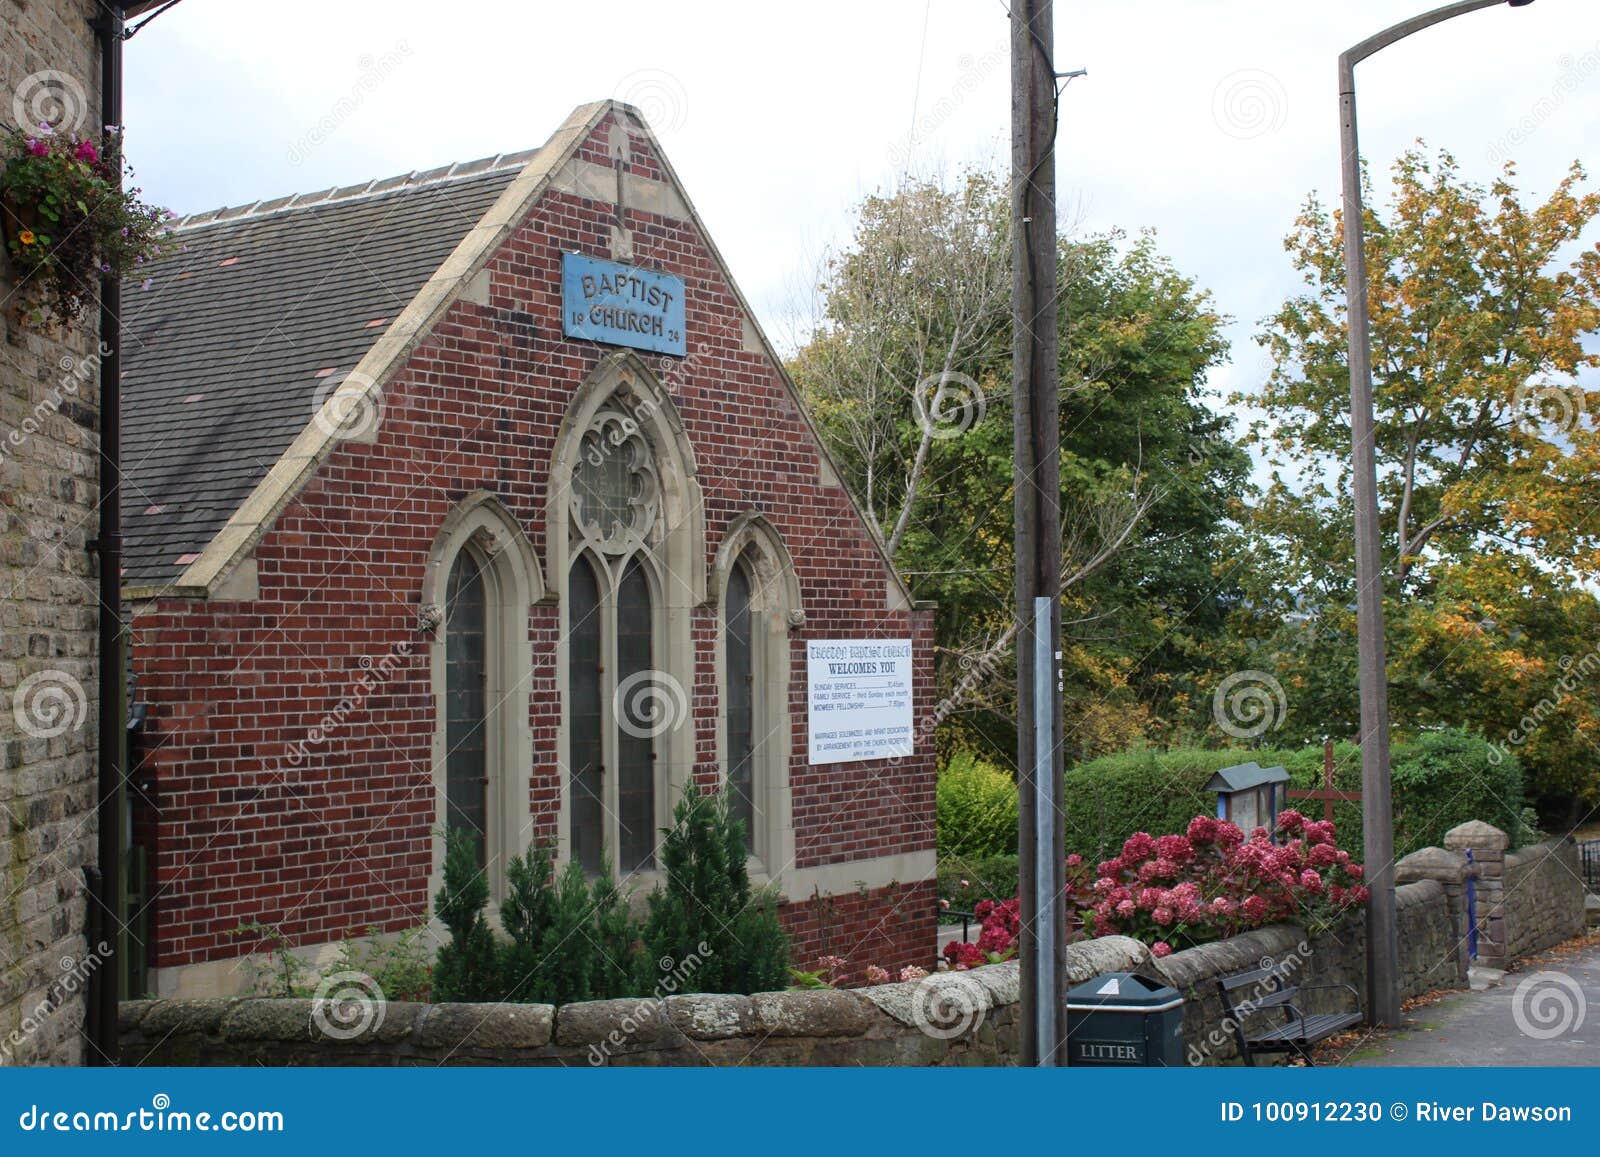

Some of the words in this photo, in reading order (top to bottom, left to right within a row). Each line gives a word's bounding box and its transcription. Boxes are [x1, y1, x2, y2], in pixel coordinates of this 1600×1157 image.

[581, 274, 673, 313] BAPTIST
[590, 304, 665, 337] CHURCH
[829, 662, 877, 675] WELCOMES
[880, 661, 896, 673] YOU
[1081, 1045, 1136, 1059] LITTER
